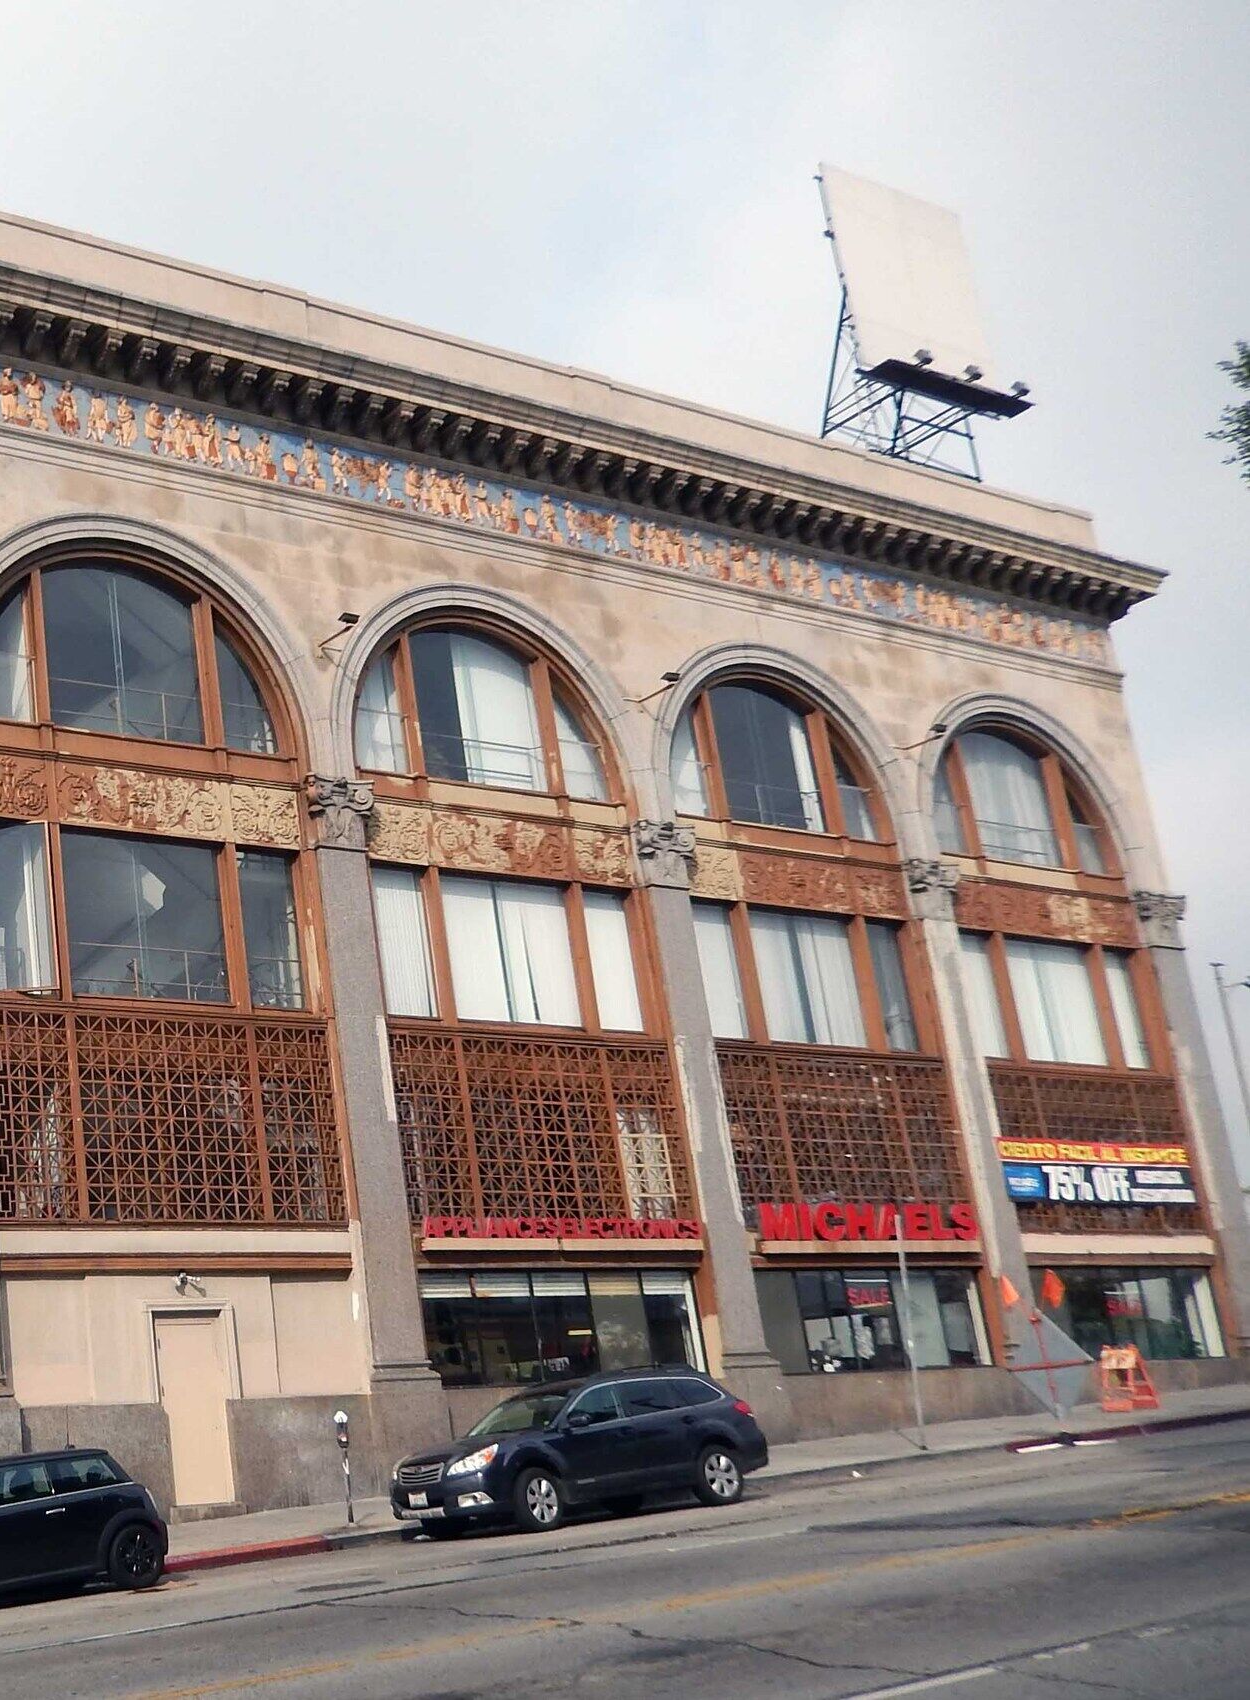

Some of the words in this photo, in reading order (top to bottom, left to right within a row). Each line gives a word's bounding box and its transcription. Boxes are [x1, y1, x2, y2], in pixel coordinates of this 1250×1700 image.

[1091, 1167, 1130, 1202] OFF
[558, 1218, 701, 1239] ELECTRONICS
[758, 1202, 980, 1241] MICHAELS
